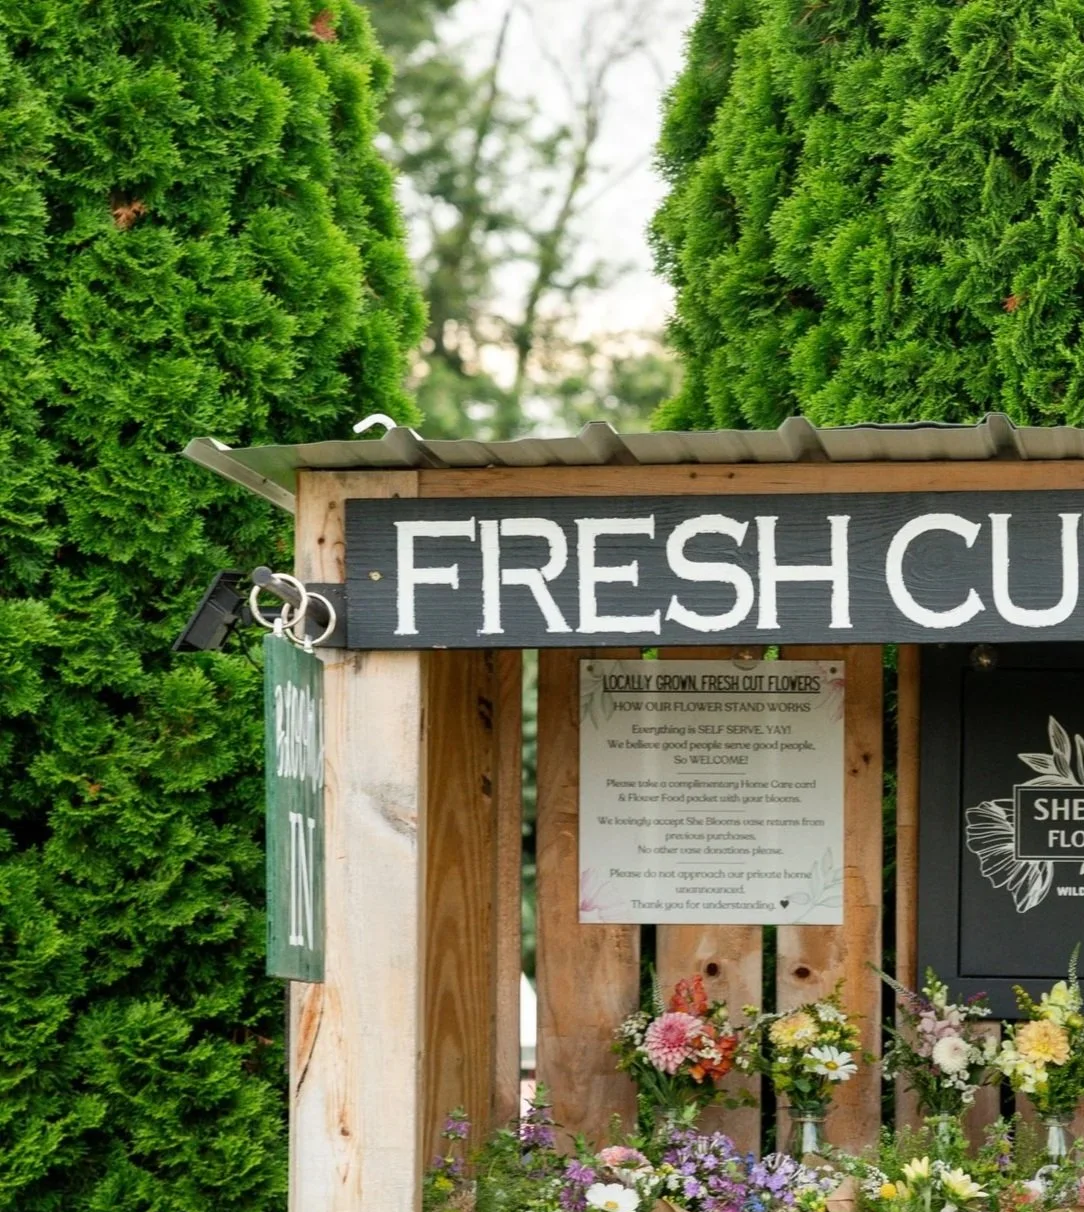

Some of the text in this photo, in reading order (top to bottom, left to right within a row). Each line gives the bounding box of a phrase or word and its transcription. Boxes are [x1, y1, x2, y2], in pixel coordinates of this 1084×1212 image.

[393, 513, 852, 636] FRESH
[603, 675, 650, 691] LOCALLY
[702, 675, 739, 691] FRESH
[743, 675, 763, 691] CUT
[769, 675, 820, 691] FLOWERS
[614, 701, 811, 712] HOW OUR FLOWER STAND WORKS
[632, 724, 685, 736] Everything
[688, 724, 696, 736] is
[698, 724, 723, 736] SELF
[608, 739, 623, 751] We
[626, 739, 654, 751] believe
[657, 739, 687, 751] good
[690, 739, 722, 751] people
[724, 739, 749, 751] serve
[752, 739, 778, 751] good
[674, 755, 748, 765] So WELCOME!
[607, 778, 816, 790] Please take a complimentary Home Care card
[618, 793, 626, 804] &
[628, 793, 659, 804] Flower
[661, 793, 684, 804] Food
[687, 793, 717, 804] packet
[720, 793, 740, 804] with
[742, 793, 762, 804] your
[598, 815, 824, 827] We lovingly accept She Blooms vase returns from
[665, 831, 704, 841] previous
[638, 845, 651, 855] No
[654, 845, 677, 855] other
[680, 845, 702, 855] vase
[704, 845, 749, 855] donations
[610, 868, 812, 880] Please do not approach our private home
[289, 812, 316, 950] IN
[631, 899, 663, 910] Thank
[665, 899, 684, 910] you
[686, 899, 700, 910] for
